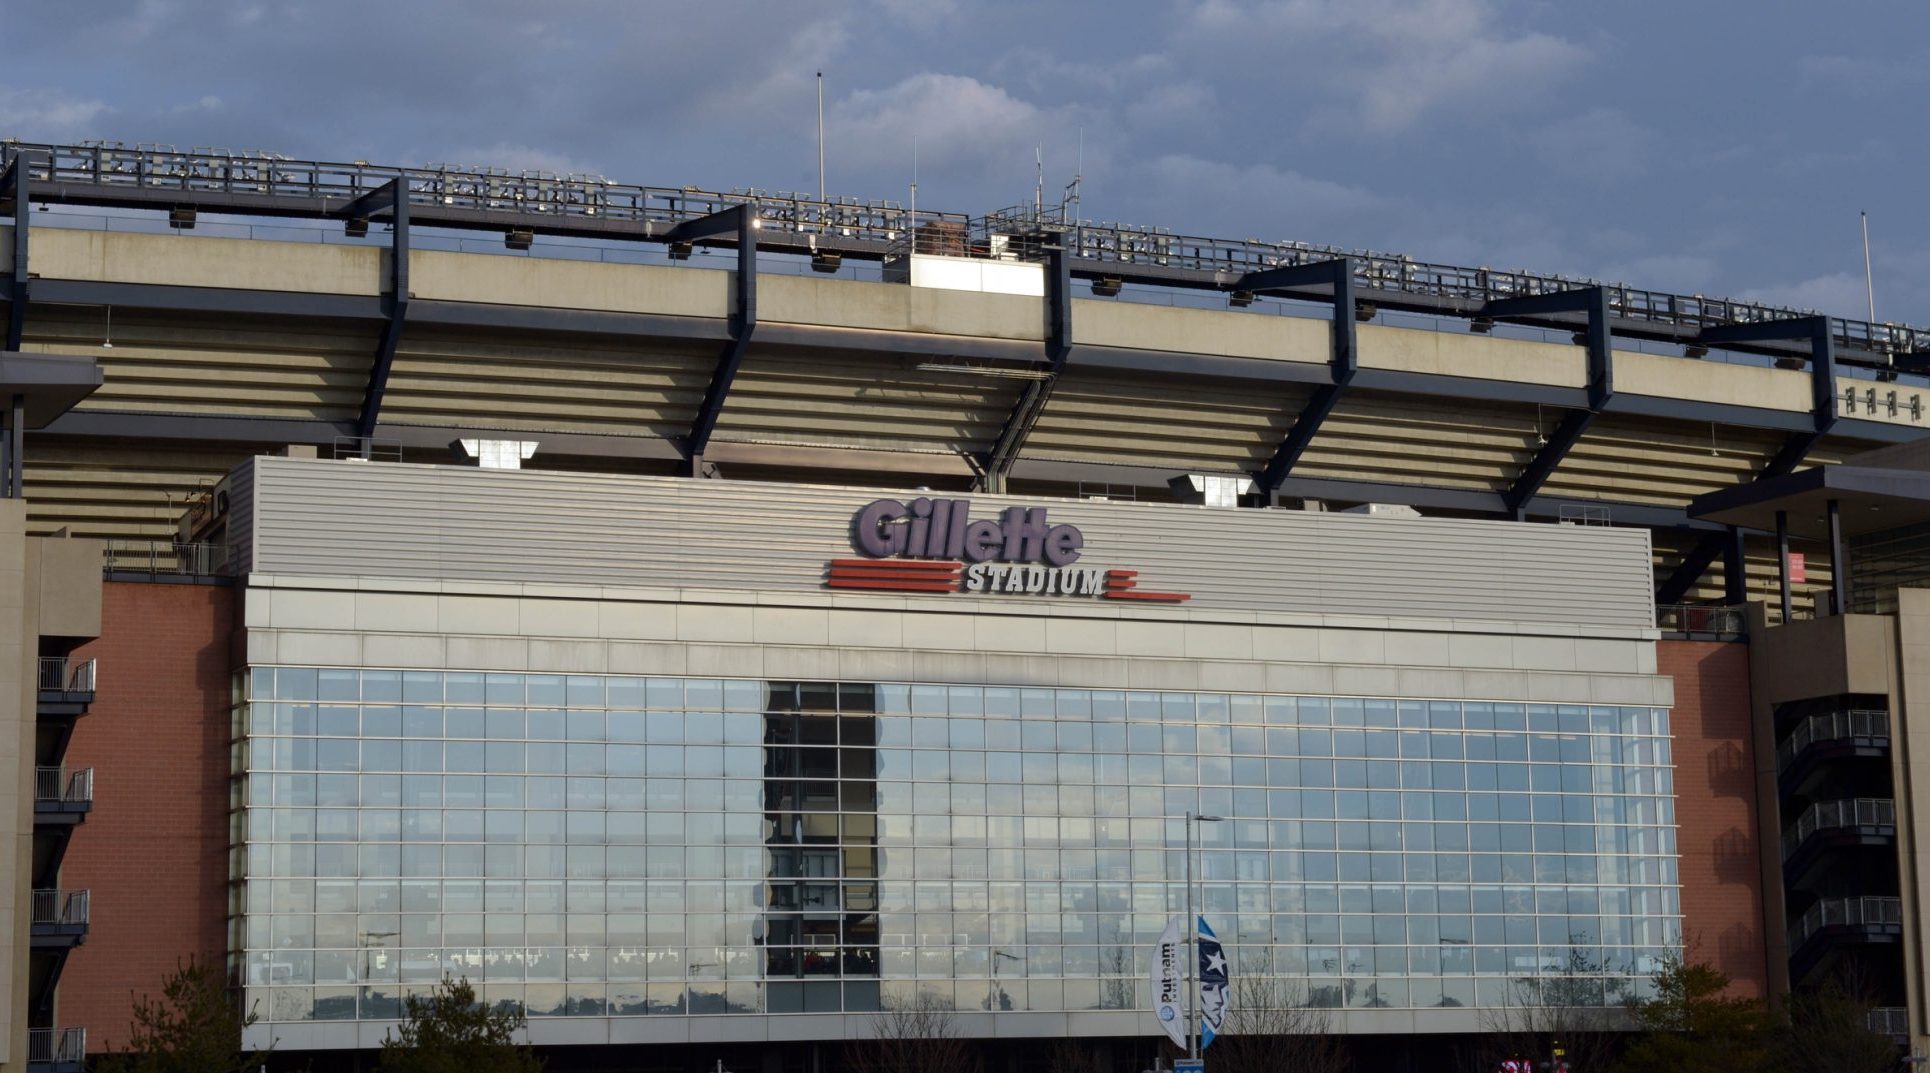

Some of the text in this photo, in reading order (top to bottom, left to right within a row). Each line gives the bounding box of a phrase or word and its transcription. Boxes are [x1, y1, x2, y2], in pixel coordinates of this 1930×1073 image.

[857, 497, 1083, 565] Gillette
[967, 565, 1103, 595] STADIUM
[1161, 943, 1172, 1003] Putnam
